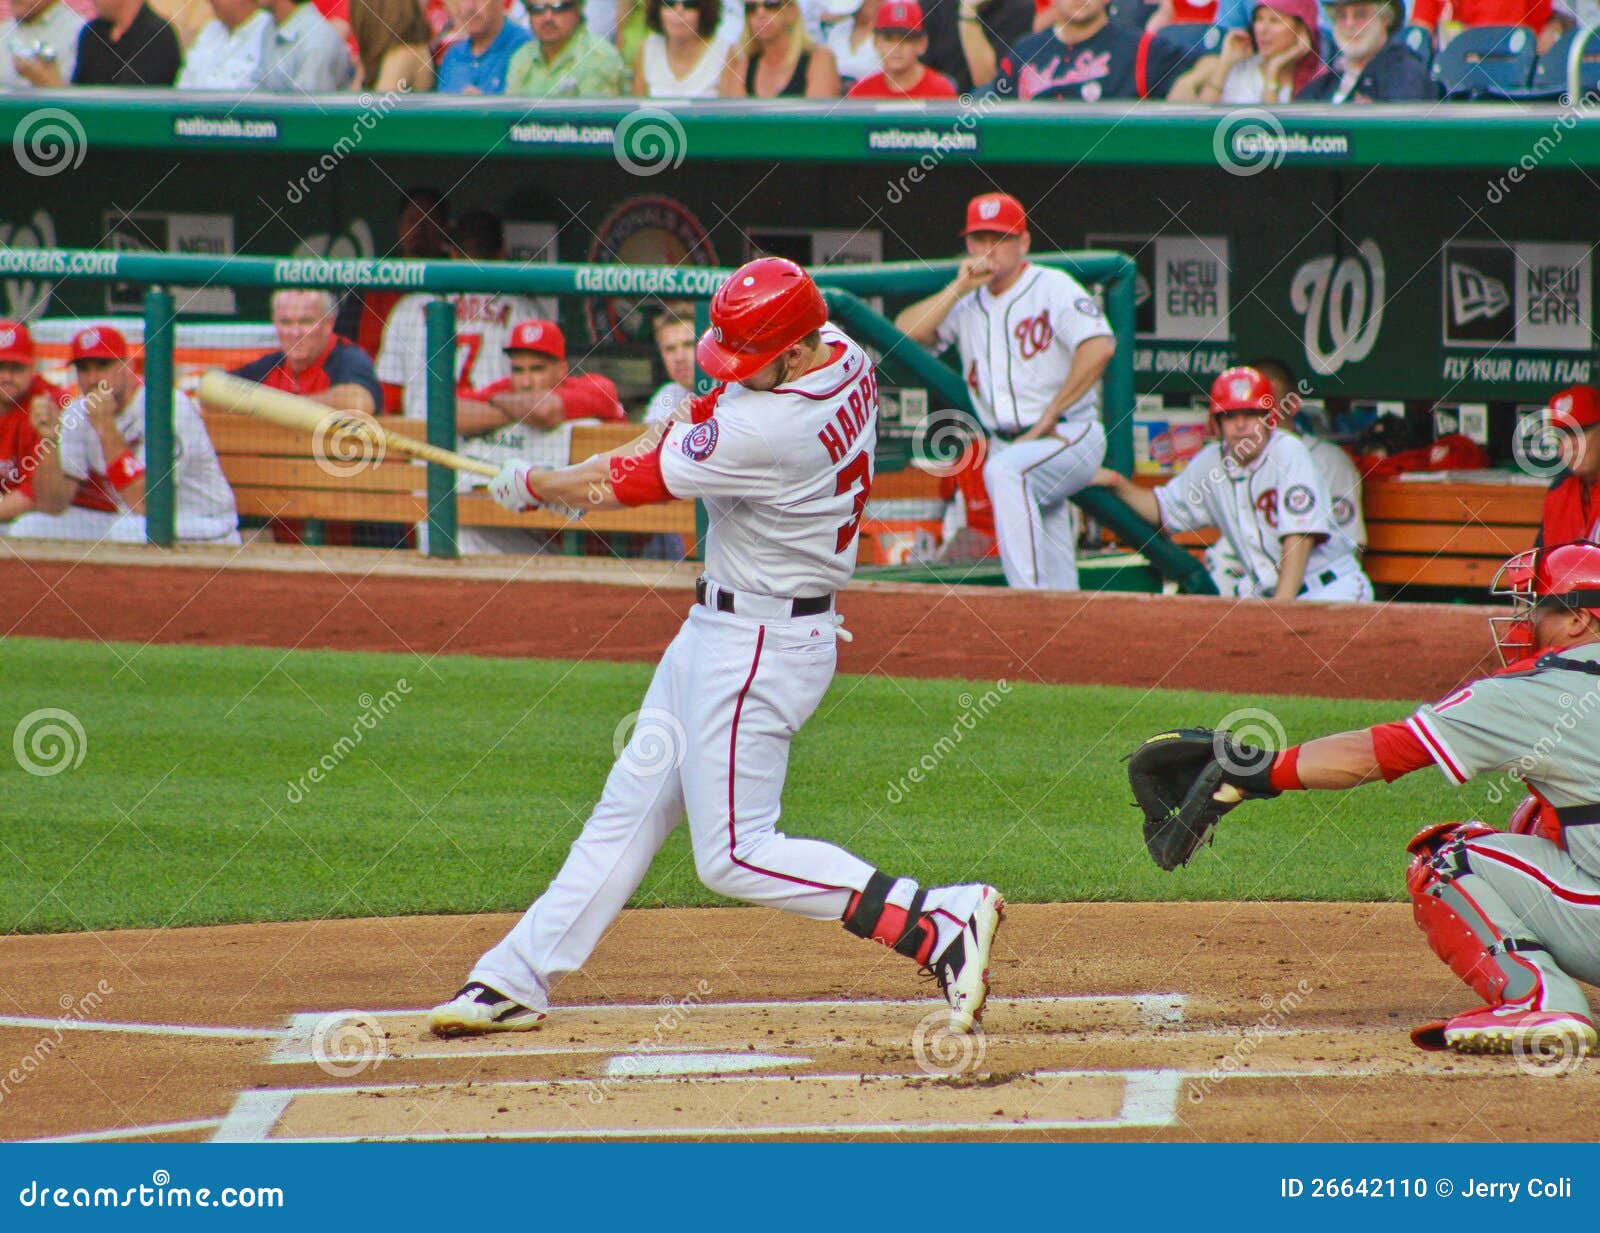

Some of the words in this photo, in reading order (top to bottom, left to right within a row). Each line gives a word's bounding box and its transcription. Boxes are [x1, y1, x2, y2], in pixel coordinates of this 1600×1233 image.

[174, 116, 277, 137] nationals.com
[511, 123, 615, 143] nationals.com
[869, 129, 977, 150] nationals.com
[1236, 133, 1348, 154] nationals.com
[275, 258, 426, 285] nationals.com
[1166, 260, 1218, 288] NEW
[1527, 266, 1580, 294] NEW
[1166, 290, 1218, 317] ERA
[1527, 297, 1580, 325] ERA
[1133, 350, 1154, 371] UR
[1155, 350, 1192, 373] OWN
[1192, 351, 1228, 374] FLAG
[1442, 357, 1471, 379] FLY
[1473, 357, 1512, 381] YOUR
[1514, 358, 1552, 382] OWN
[1553, 360, 1591, 383] FLAG
